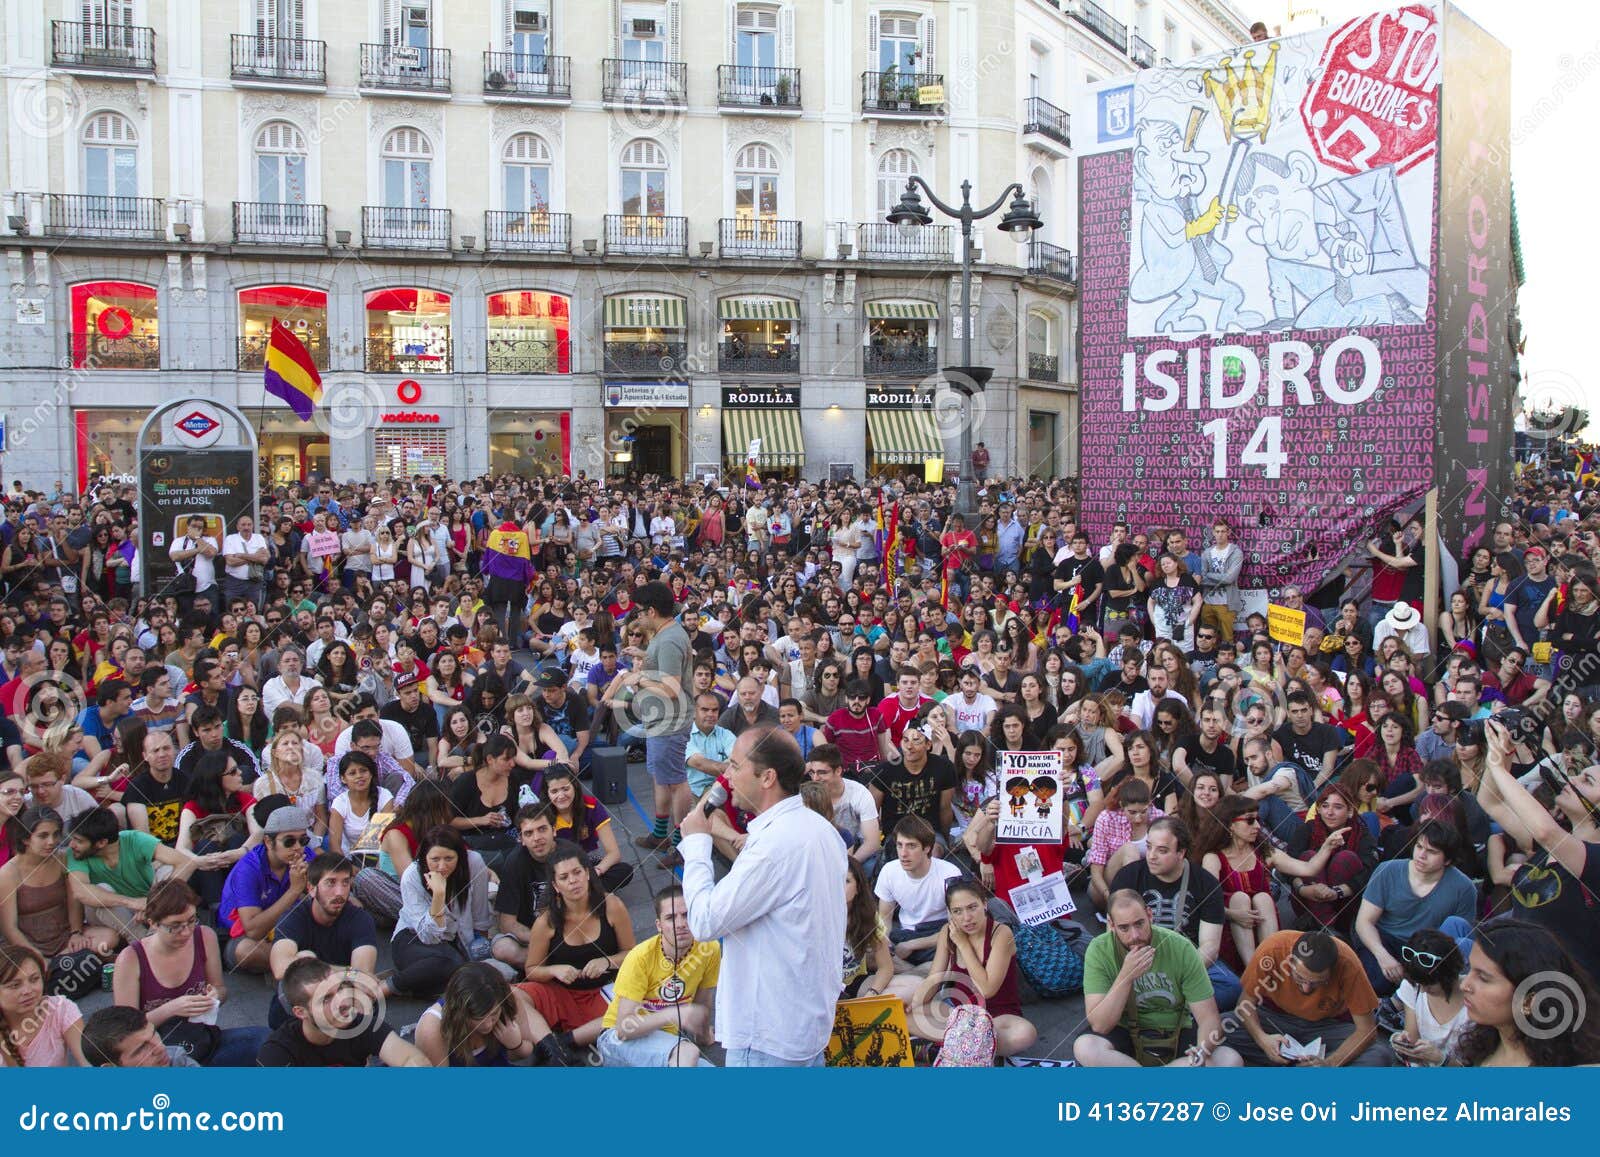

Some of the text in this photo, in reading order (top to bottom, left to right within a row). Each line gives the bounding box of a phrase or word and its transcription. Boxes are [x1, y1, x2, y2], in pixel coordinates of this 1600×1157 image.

[1083, 154, 1117, 169] MORA
[1083, 187, 1120, 201] PONCE
[1083, 210, 1120, 224] RITTER
[1083, 221, 1120, 235] FINITO
[1083, 232, 1125, 246] PERERA
[1083, 243, 1128, 257] LAMELA
[1082, 255, 1121, 268] CURRO
[1083, 265, 1129, 279] HERMOS
[1083, 277, 1129, 291] DIEGUEZ
[1083, 289, 1120, 302] MARIN
[1082, 300, 1116, 313] MORA
[1082, 311, 1126, 324] ROBLEN
[1467, 195, 1489, 443] ISIDRO
[1082, 321, 1126, 334] GARRID
[1082, 333, 1120, 346] PONCE
[1382, 334, 1435, 349] FORTES
[1082, 344, 1134, 357] VENTURA
[1082, 356, 1120, 368] RITTER
[1082, 367, 1119, 379] FINITO
[1123, 335, 1382, 411] ISIDRO
[1397, 375, 1435, 387] ROJO
[728, 393, 794, 403] RODILLA
[869, 393, 933, 404] RODILLA
[1082, 387, 1435, 401] LAMEL GALAN
[1082, 401, 1120, 412] CURRO
[381, 411, 440, 424] vodafone
[1081, 412, 1138, 423] HERMOSO
[1148, 410, 1196, 421] MANUEL
[1296, 404, 1355, 417] AGUILAR
[185, 421, 210, 429] Metro
[1081, 414, 1434, 434] DIEGUEZ VENEGAS RDIALES FERNANDES
[1081, 434, 1117, 444] MARIN
[1128, 433, 1170, 444] MOURA
[1350, 428, 1434, 440] RAFAELILLO
[1081, 445, 1115, 455] MORA
[1123, 445, 1162, 456] LUQUE
[1333, 442, 1363, 453] JULI
[1375, 441, 1433, 453] GALVAN
[1203, 416, 1288, 479] 14
[151, 459, 168, 468] 4G
[1146, 456, 1180, 466] MOTA
[1321, 455, 1373, 466] ROMAN
[1384, 454, 1433, 466] TEJELA
[1081, 468, 1134, 478] GARRIDO
[1209, 468, 1260, 478] PDILLA
[1281, 467, 1351, 479] SCRIBANO
[1365, 467, 1433, 479] CAETANO
[1081, 479, 1117, 489] PONCE
[1126, 479, 1180, 490] CASTELLA
[1190, 480, 1230, 490] GALAN
[1240, 480, 1296, 491] ABELLAN
[1308, 480, 1350, 491] FANDI
[158, 496, 211, 505] en el ADSL
[1081, 490, 1133, 500] VENTURA
[1144, 491, 1214, 502] HERNANDEZ
[1224, 492, 1278, 502] ROMERO
[1289, 492, 1345, 504] PAULITA
[1081, 501, 1117, 511] RITTER
[1128, 503, 1173, 512] ESPADA
[1183, 503, 1243, 514] GONGORA
[1320, 506, 1364, 517] CAPEA
[1081, 512, 1117, 522] FINITO
[1127, 514, 1180, 525] MORANTE
[1081, 523, 1113, 534] PERER
[1008, 755, 1027, 768] YO
[1023, 902, 1074, 926] IMPUTADOS
